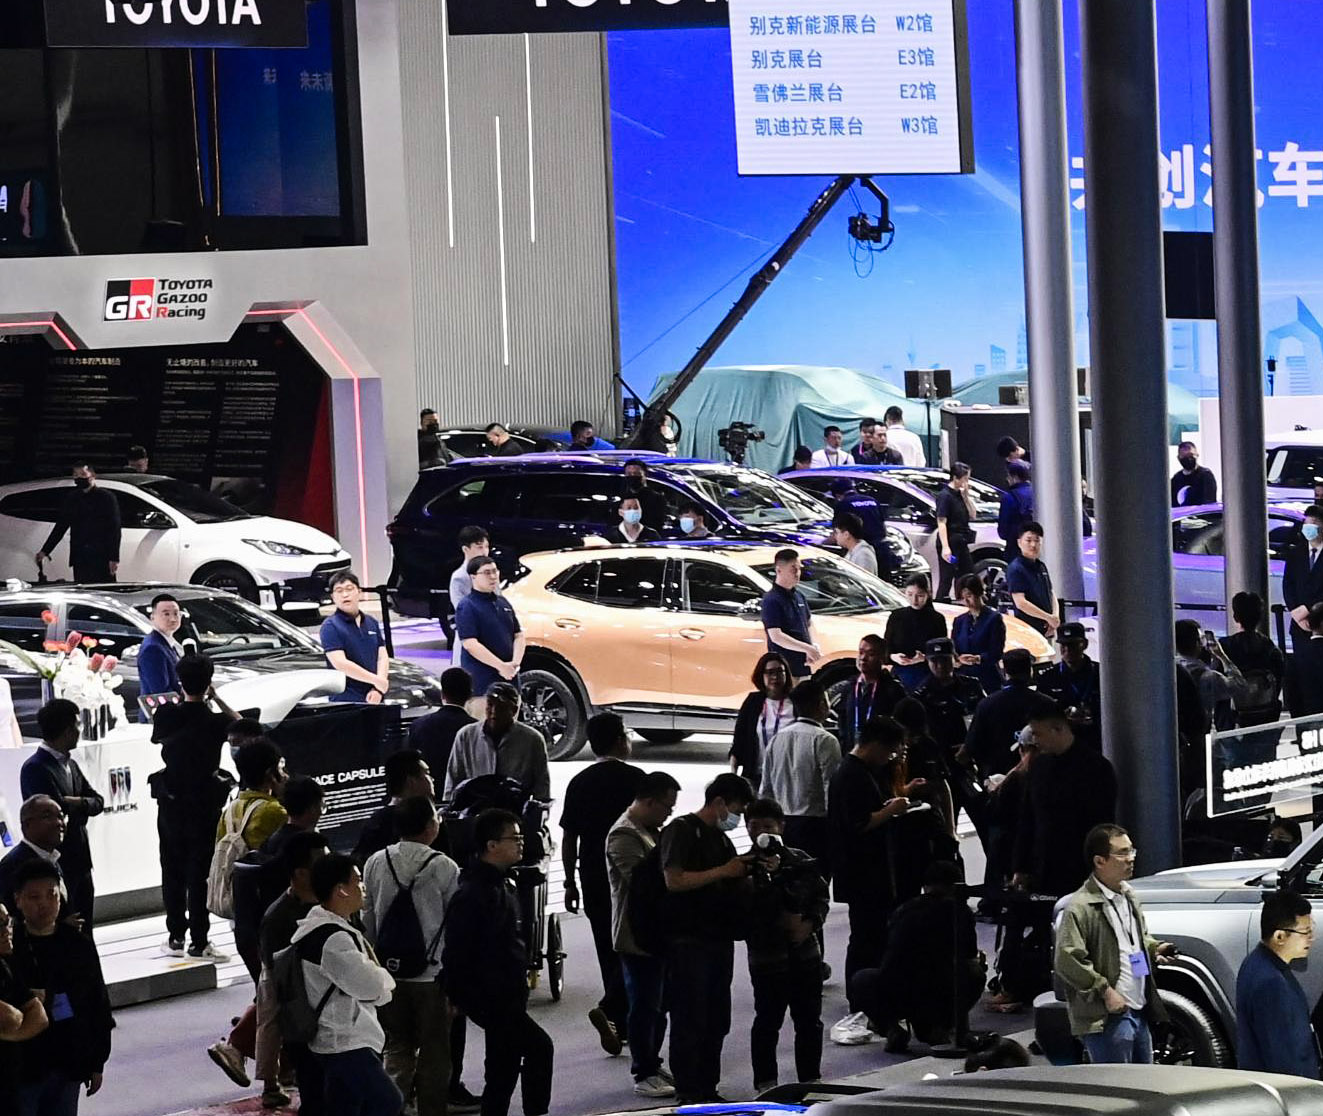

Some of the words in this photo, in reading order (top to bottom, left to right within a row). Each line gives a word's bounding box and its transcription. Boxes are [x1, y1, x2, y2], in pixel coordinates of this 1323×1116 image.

[749, 15, 876, 35] 别克新能源展台
[895, 13, 934, 33] W2馆
[751, 50, 823, 69] 别克展台
[898, 48, 936, 67] E3馆
[753, 83, 843, 103] 雪佛兰展台
[900, 82, 937, 101] E2馆
[755, 117, 864, 137] 凯迪拉克展台
[901, 116, 938, 135] W3馆
[158, 279, 213, 290] TOYOTA
[105, 294, 153, 320] GR
[157, 293, 208, 305] GAZOO
[156, 305, 206, 320] Racing
[338, 766, 386, 782] CAPSULE
